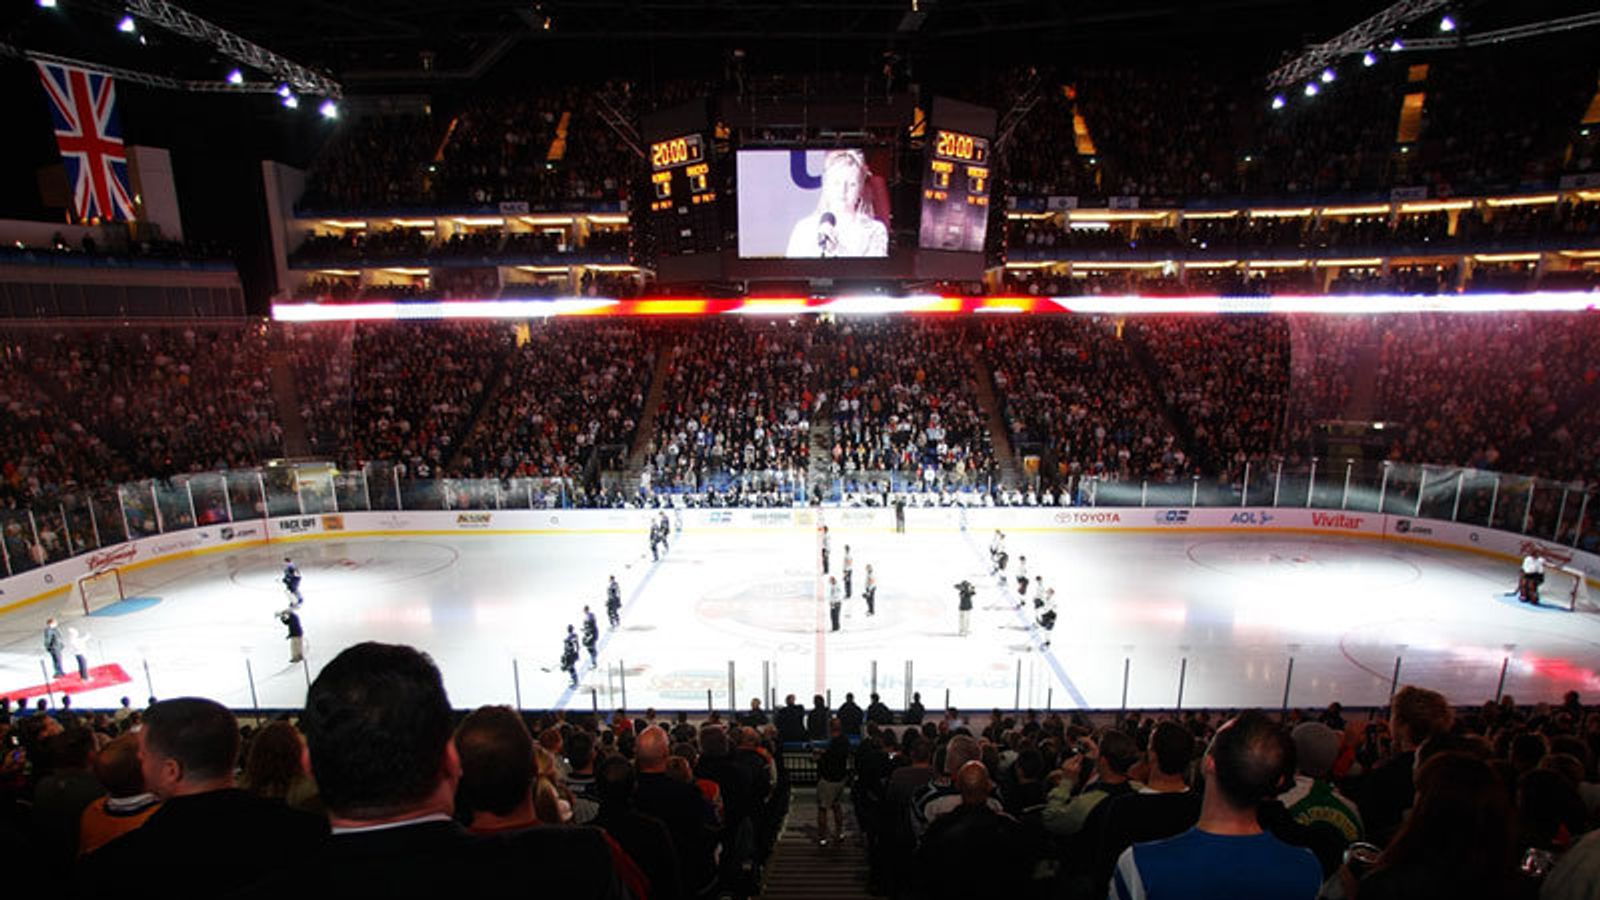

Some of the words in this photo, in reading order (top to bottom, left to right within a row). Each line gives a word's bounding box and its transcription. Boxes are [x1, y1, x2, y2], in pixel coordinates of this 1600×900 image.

[652, 139, 687, 166] 20:00
[937, 131, 973, 159] 20:00
[1073, 512, 1121, 522] TOYOTA
[1231, 512, 1256, 524] AOL
[1311, 511, 1364, 529] Vivitar
